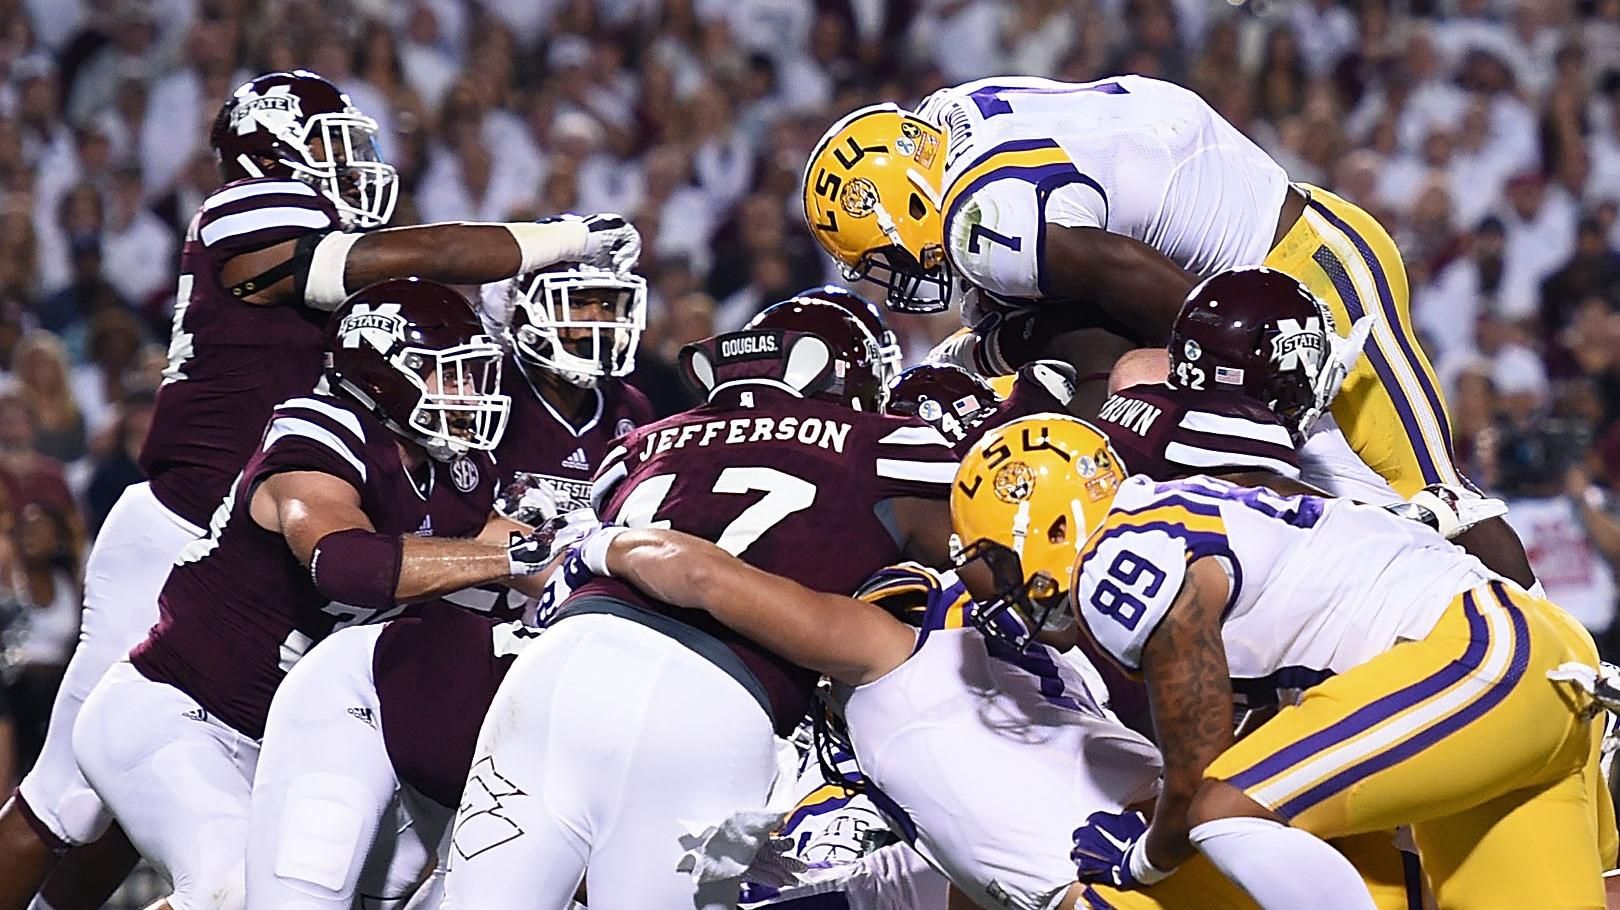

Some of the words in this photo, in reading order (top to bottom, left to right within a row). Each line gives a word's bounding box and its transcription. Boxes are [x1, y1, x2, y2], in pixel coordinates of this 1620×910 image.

[238, 98, 288, 120] STATE
[815, 136, 890, 233] LSU
[967, 223, 1022, 254] 7
[346, 314, 392, 332] STATE
[1283, 333, 1320, 353] STATE
[1177, 362, 1206, 391] 42
[639, 416, 852, 462] JEFFERSON
[959, 427, 1071, 499] LSU
[1091, 549, 1167, 631] 89
